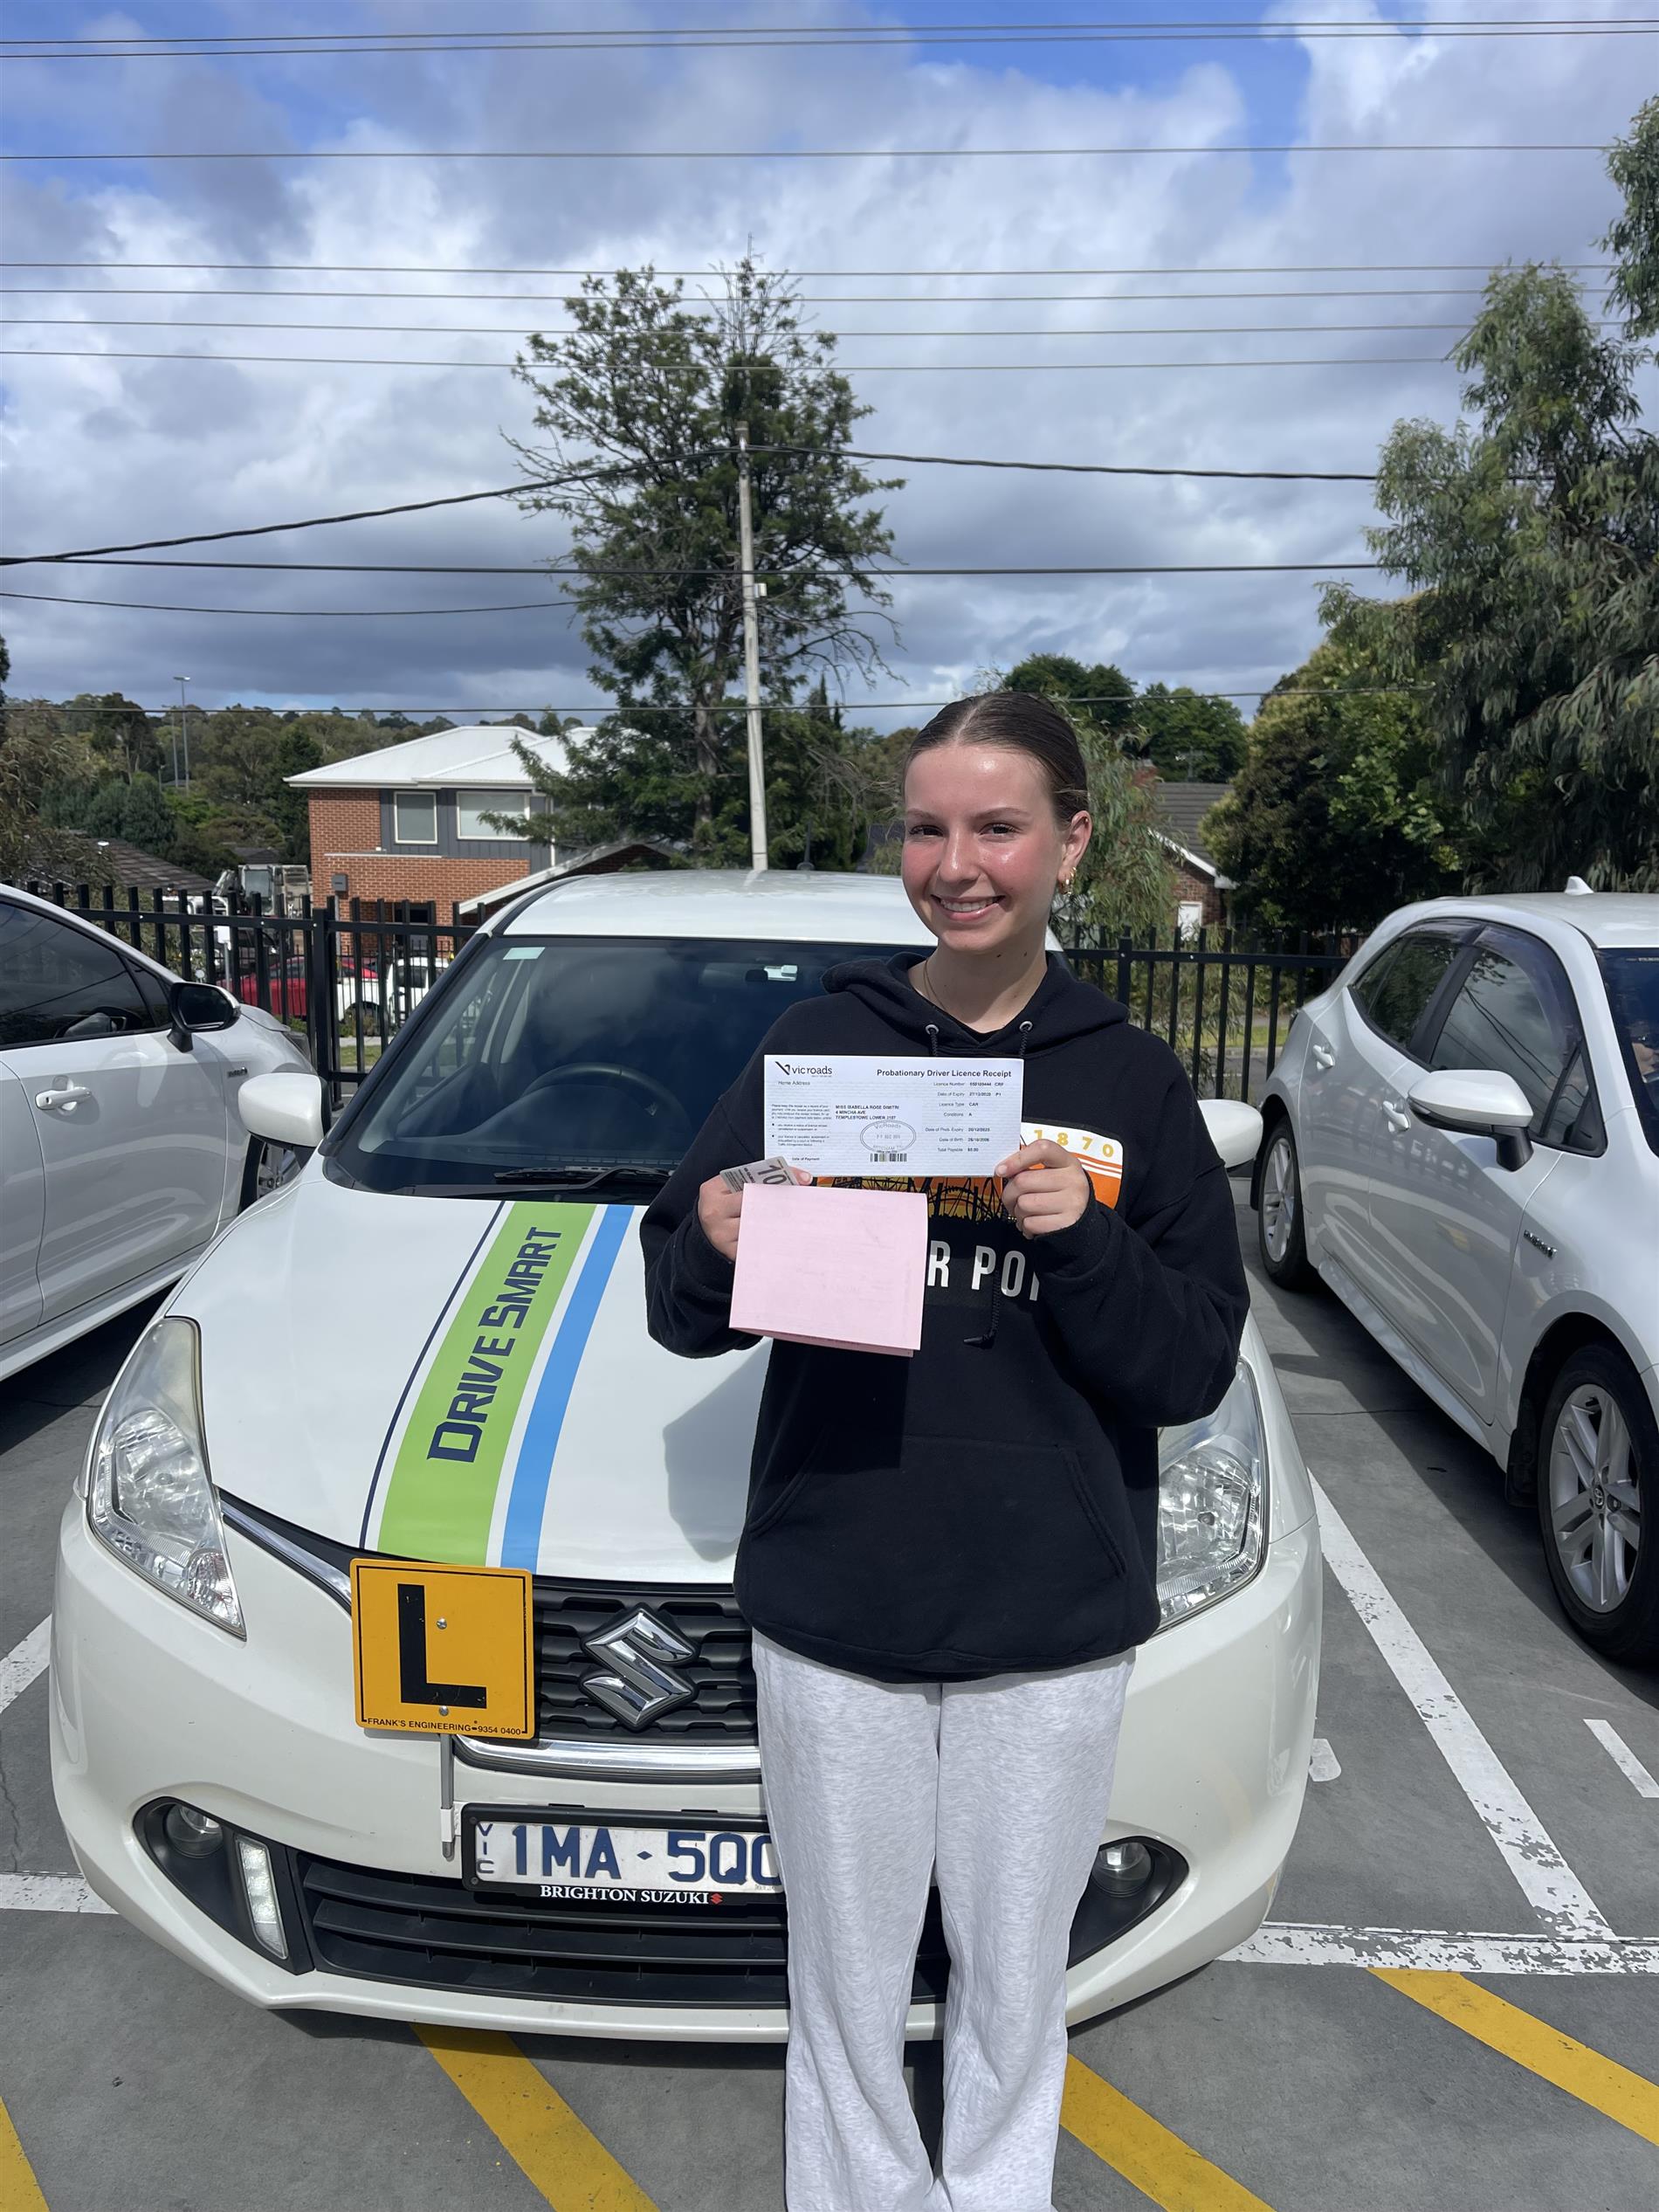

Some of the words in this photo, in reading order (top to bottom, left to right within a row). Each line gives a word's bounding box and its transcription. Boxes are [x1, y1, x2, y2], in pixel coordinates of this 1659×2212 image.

[792, 1065, 833, 1075] vicroads
[877, 1069, 925, 1078] Probationary
[982, 1070, 1012, 1078] Receipt
[1034, 1130, 1114, 1158] 1870
[971, 1245, 1040, 1301] PO
[426, 1335, 516, 1464] DRIVE
[478, 1226, 561, 1329] SMART
[397, 1583, 487, 1709] L
[368, 1718, 407, 1727] FRANK'S
[476, 1823, 494, 1874] VIC
[539, 1885, 638, 1903] BRIGHTON
[639, 1890, 710, 1905] SUZUKI
